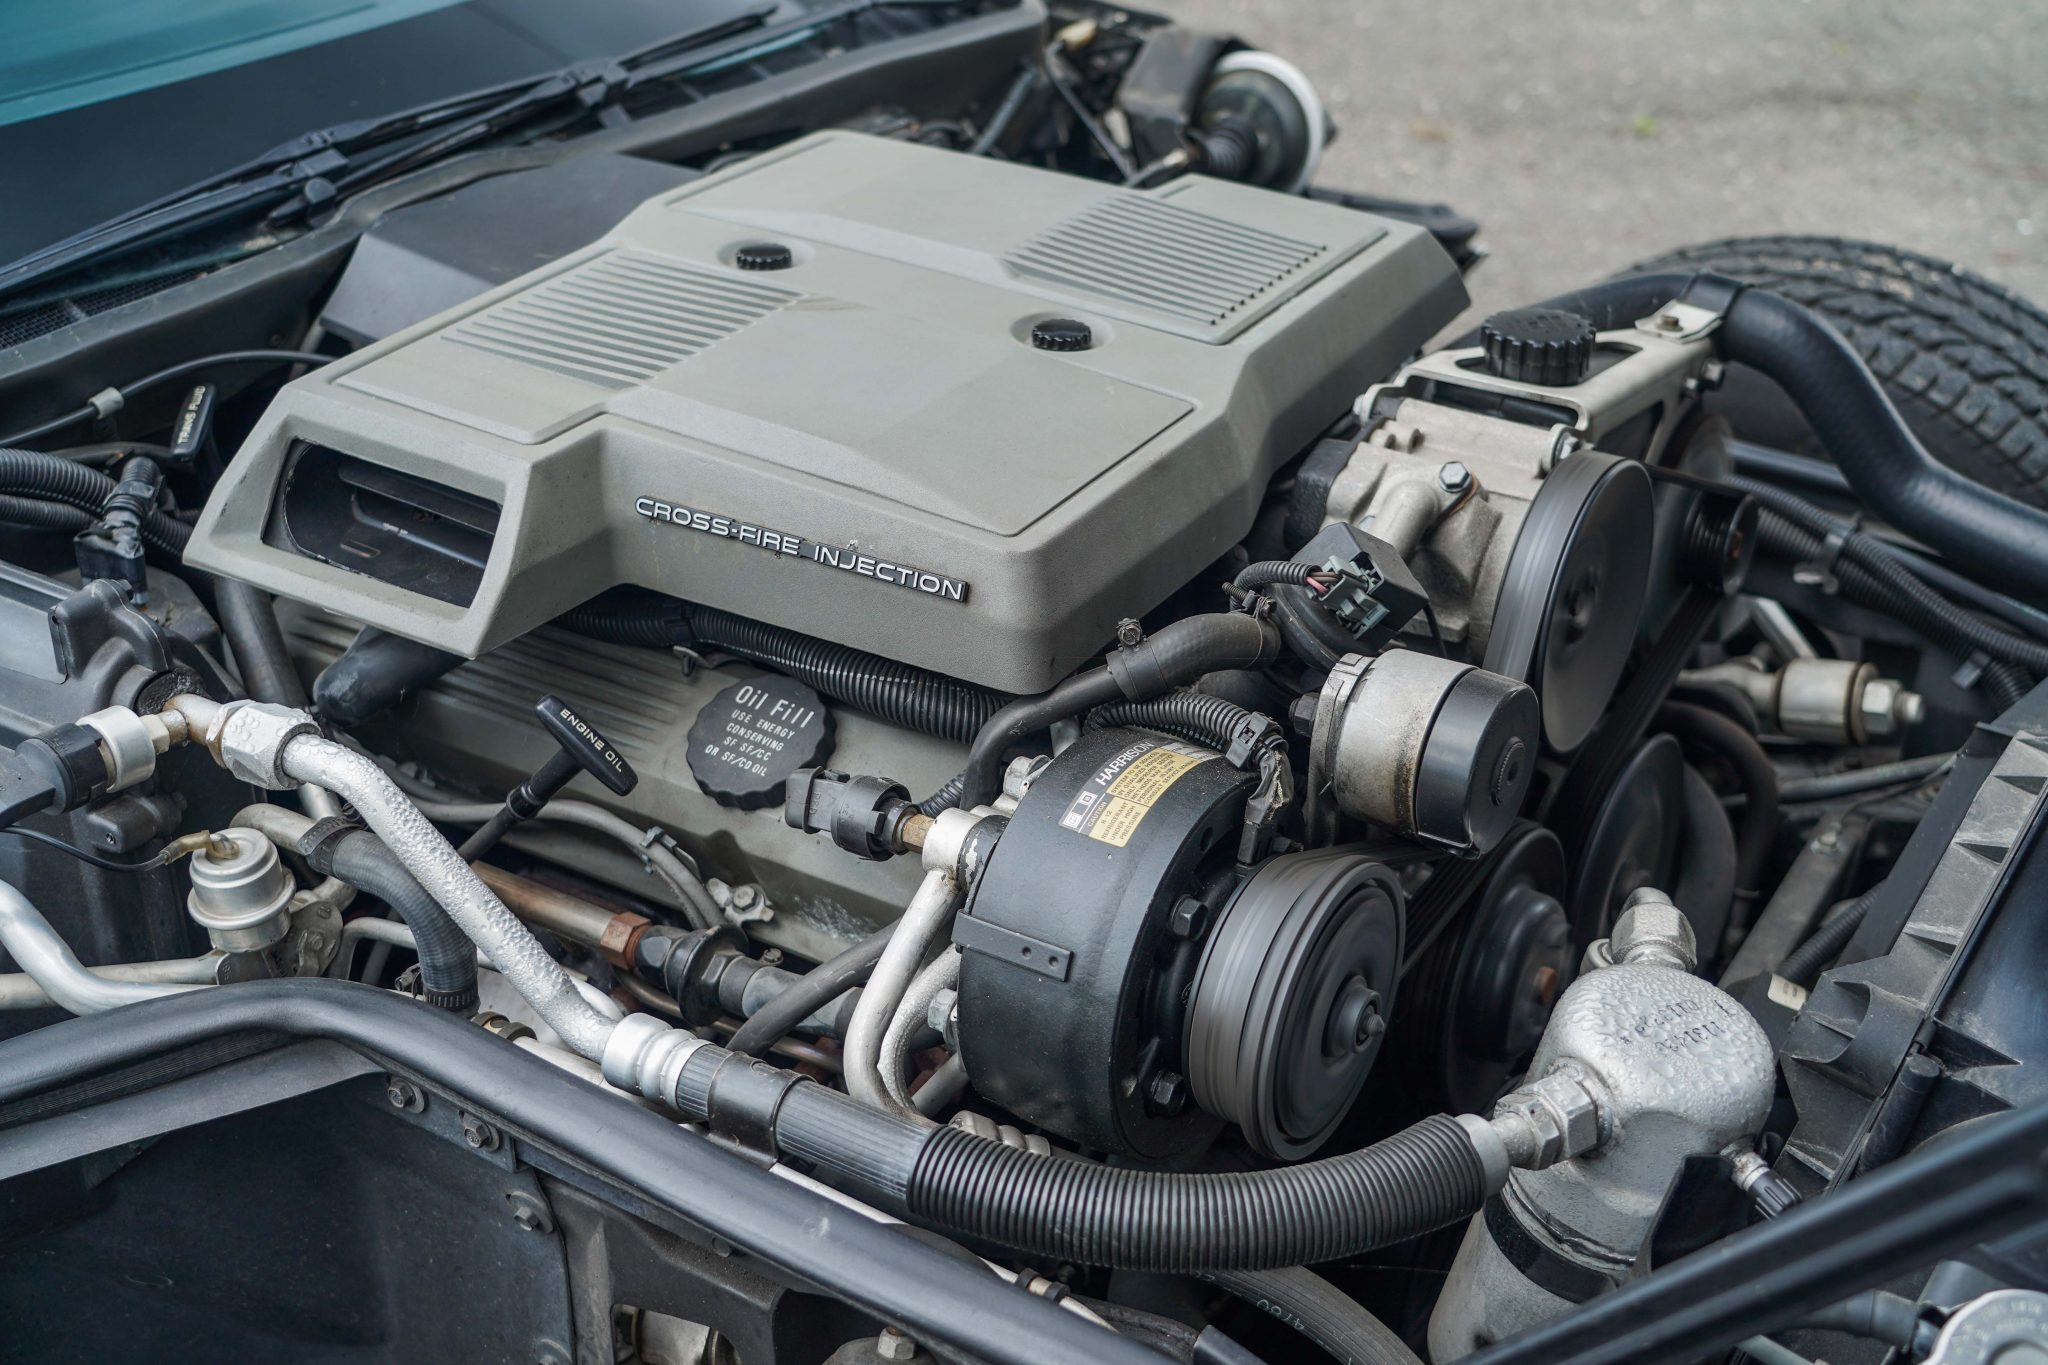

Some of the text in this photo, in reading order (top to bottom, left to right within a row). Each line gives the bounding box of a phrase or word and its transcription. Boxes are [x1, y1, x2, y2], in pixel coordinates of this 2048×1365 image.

[636, 498, 964, 601] CROSS-FIRE INJECTION
[735, 685, 815, 729] Oil Fill
[726, 722, 785, 752] CONSERVING
[731, 709, 796, 740] USE ENERGY
[560, 708, 623, 773] ENGINE OIL
[723, 736, 772, 761] SF SF/CC
[704, 744, 769, 777] OR SF/CD OIL
[1095, 741, 1155, 786] HARRISON
[1111, 775, 1129, 793] SYSTEM
[1127, 769, 1136, 777] TO
[1124, 785, 1137, 798] ONLY
[1130, 778, 1153, 800] METHODS
[1136, 779, 1160, 802] PERSONAL
[1143, 783, 1164, 804] CONSULT
[1087, 801, 1108, 827] CAUTION
[1101, 802, 1129, 839] REFRIGERANT
[1120, 811, 1141, 840] PRESSURE
[1110, 820, 1125, 841] UNDER
